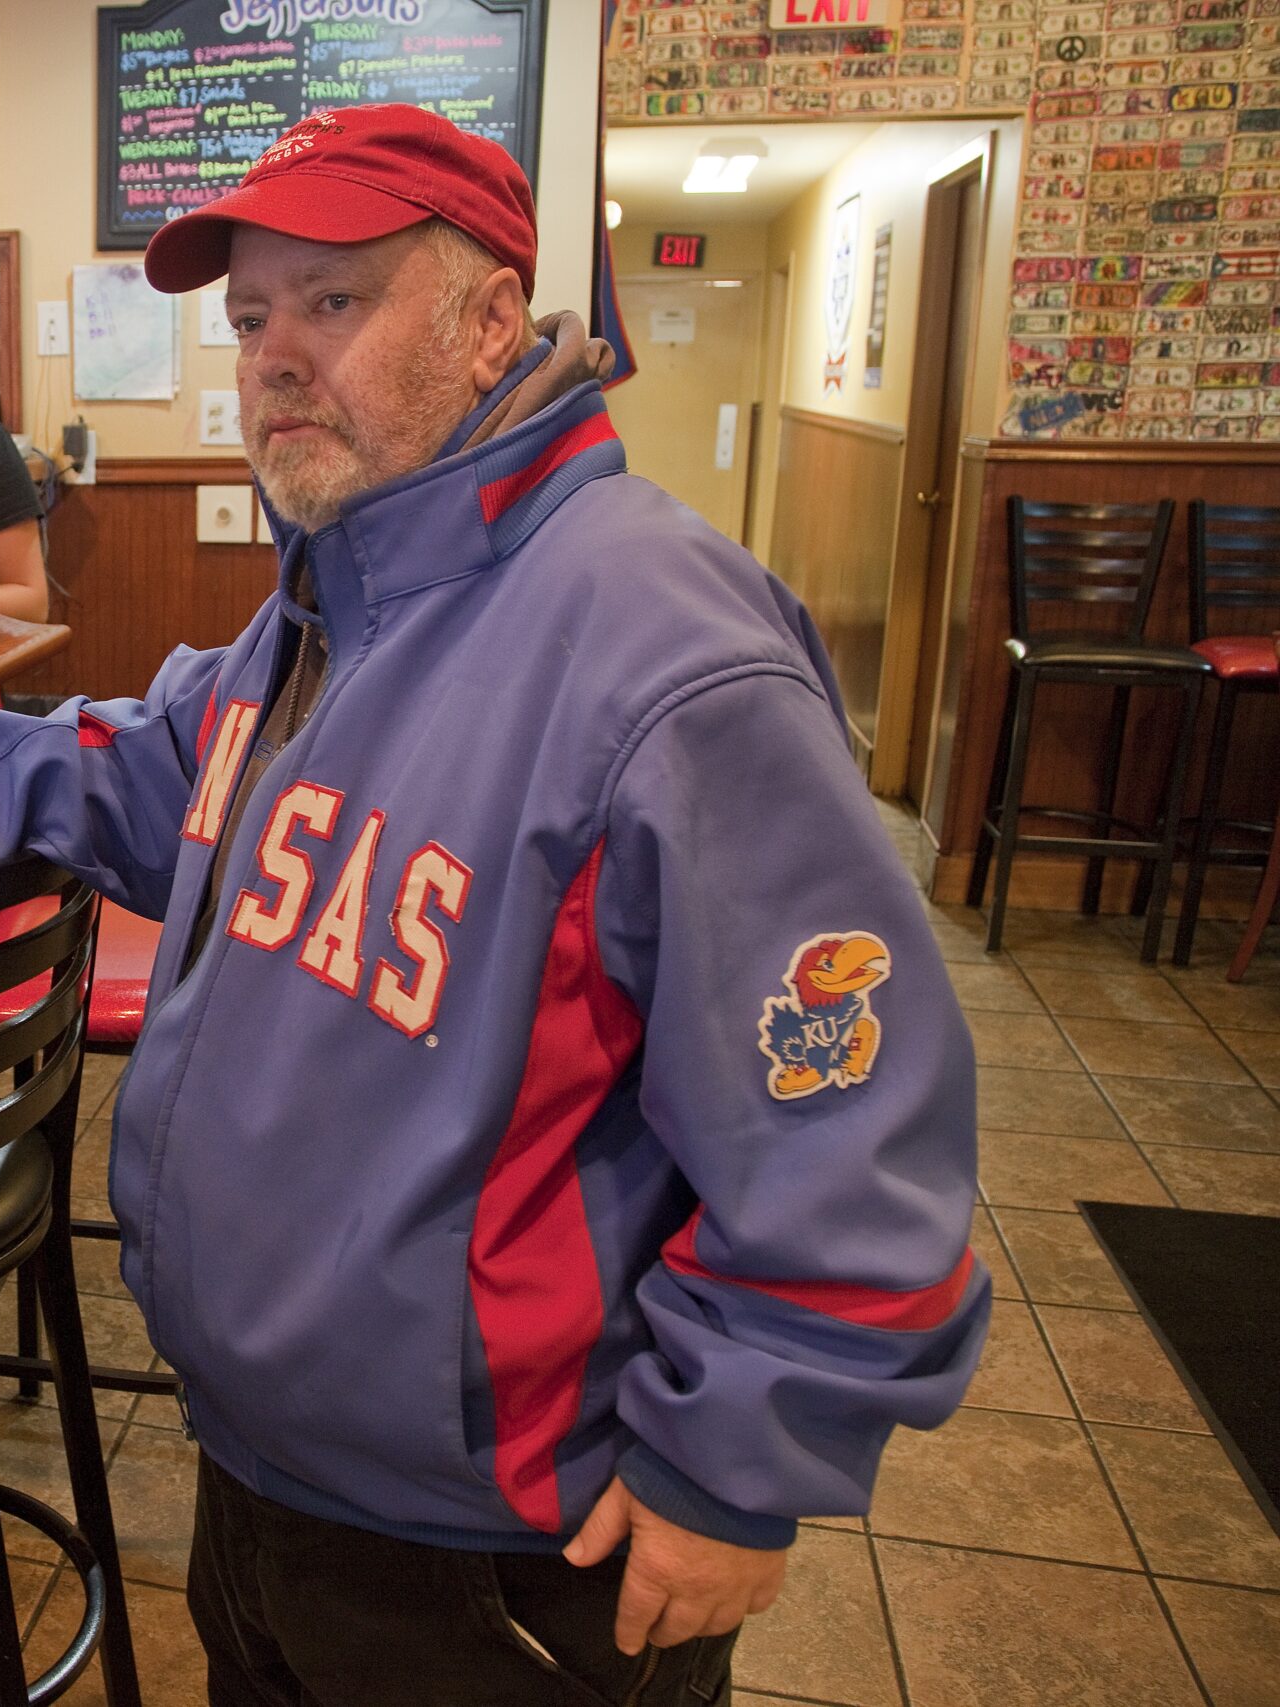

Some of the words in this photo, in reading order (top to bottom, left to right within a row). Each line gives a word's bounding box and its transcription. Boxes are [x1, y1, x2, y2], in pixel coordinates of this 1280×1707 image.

[267, 140, 315, 165] VEGAS
[660, 236, 699, 265] EXIT
[800, 1016, 838, 1049] KU
